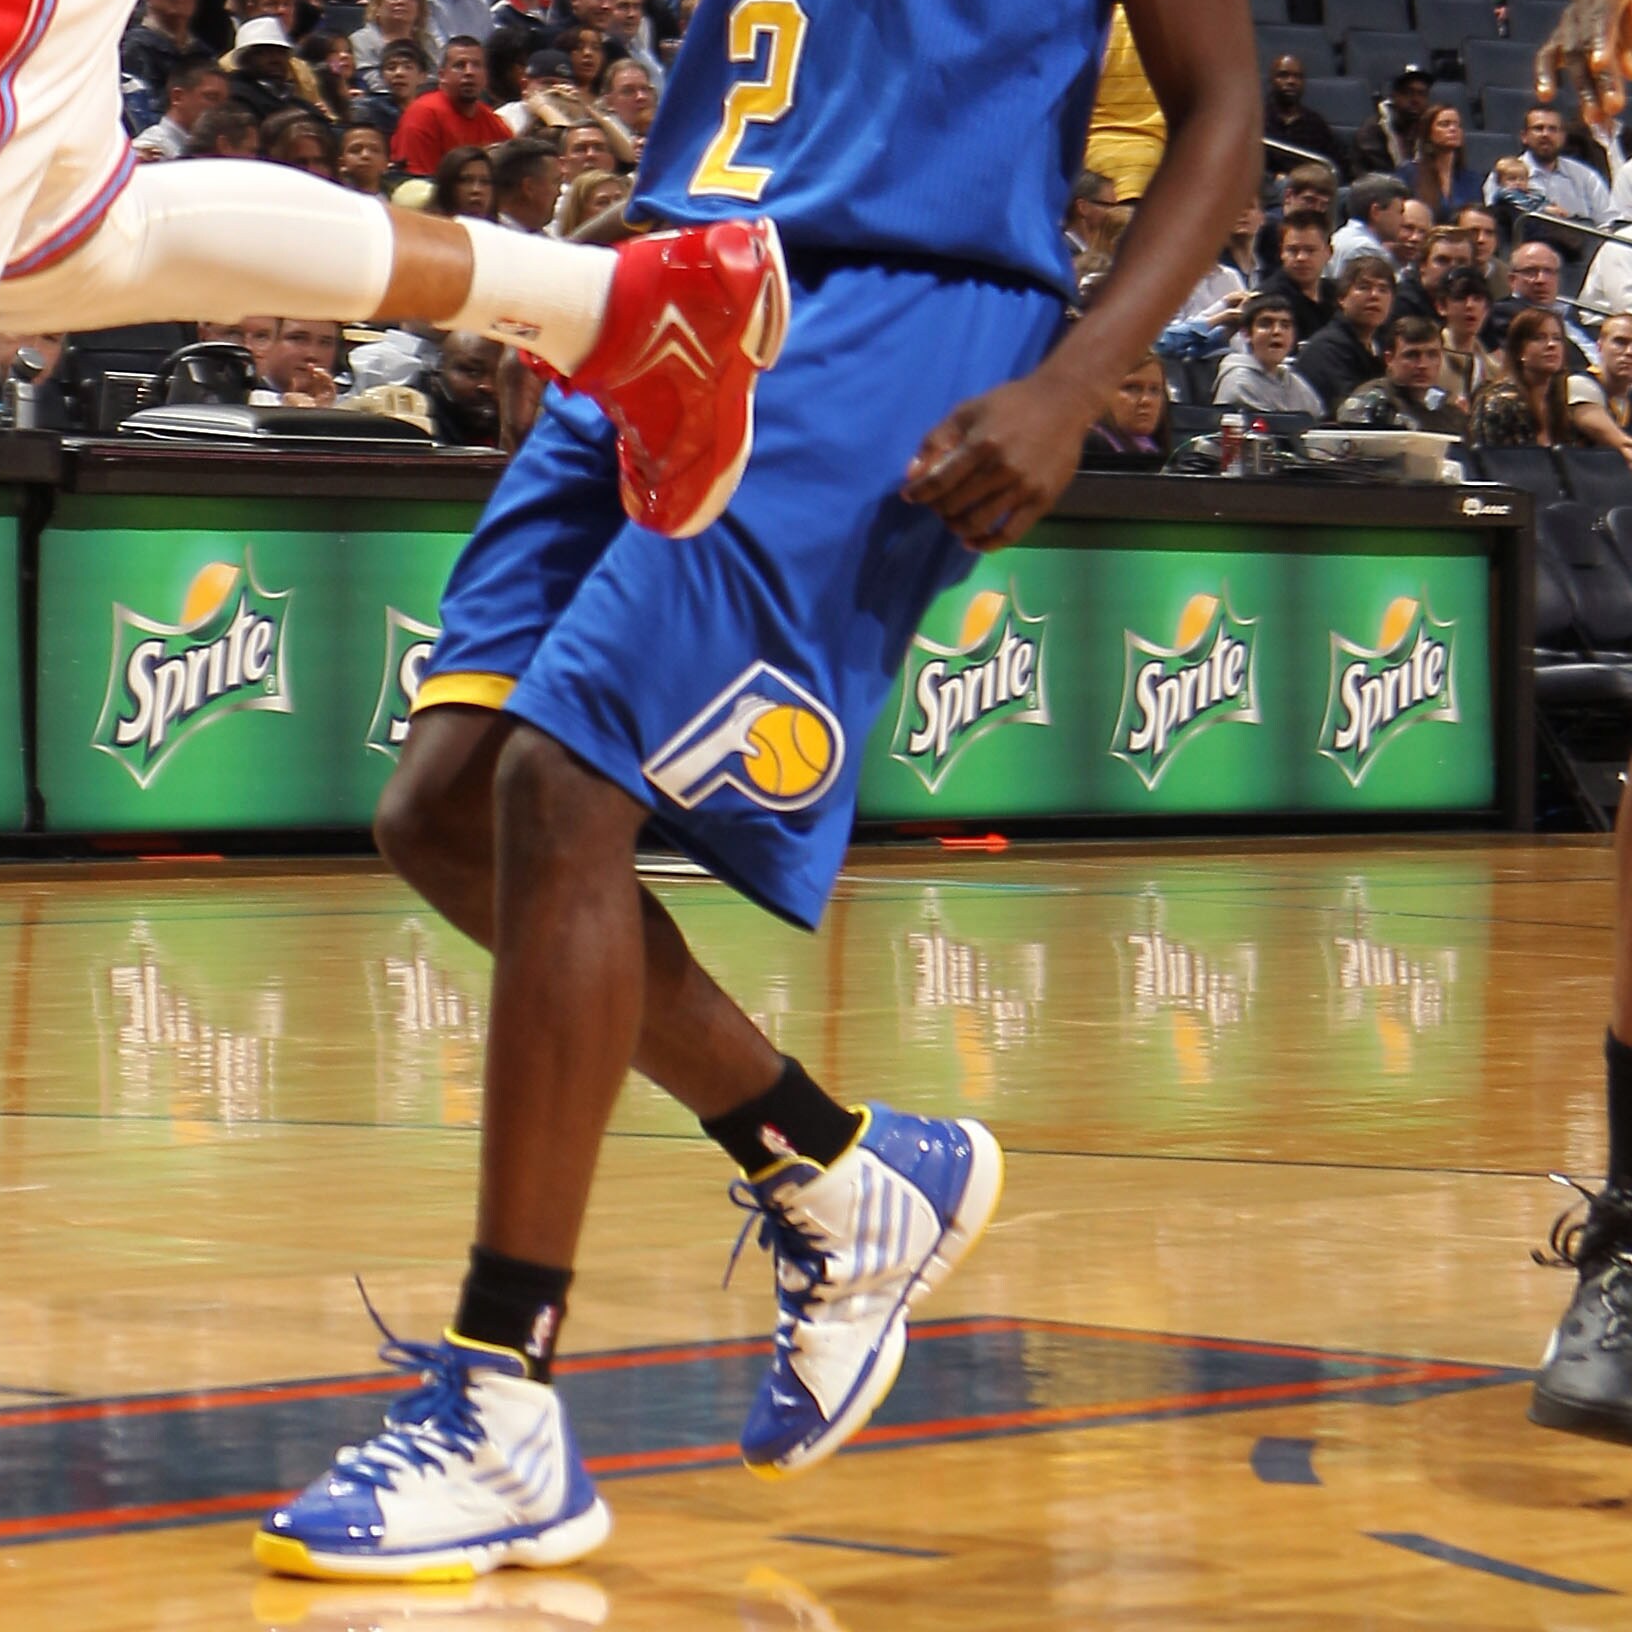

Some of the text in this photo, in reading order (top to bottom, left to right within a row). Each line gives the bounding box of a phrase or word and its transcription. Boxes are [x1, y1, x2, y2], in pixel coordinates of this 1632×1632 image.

[116, 588, 274, 761] Sprite
[908, 612, 1035, 762] Sprite
[1129, 616, 1247, 761] Sprite
[1333, 620, 1447, 758] Sprite
